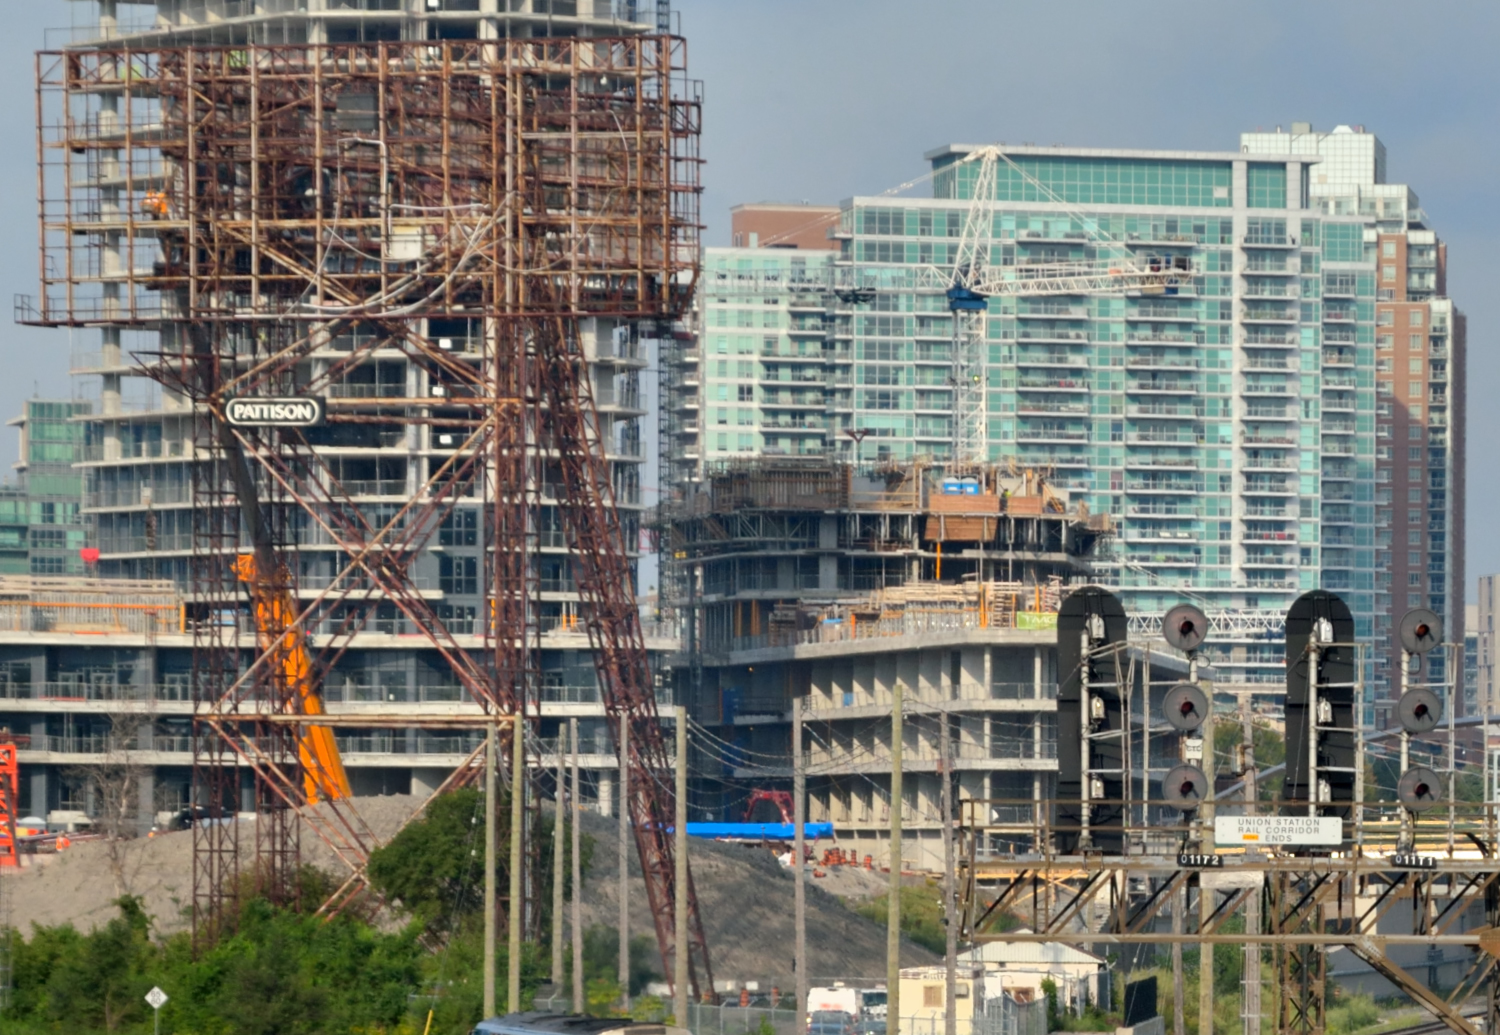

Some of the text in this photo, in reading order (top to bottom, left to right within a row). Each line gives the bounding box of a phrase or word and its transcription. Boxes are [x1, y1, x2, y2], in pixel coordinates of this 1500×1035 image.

[233, 403, 312, 420] PATTISON
[1238, 818, 1320, 826] UNION STATION
[1238, 826, 1320, 834] RAIL CORRIDOR
[1265, 834, 1293, 842] ENDS
